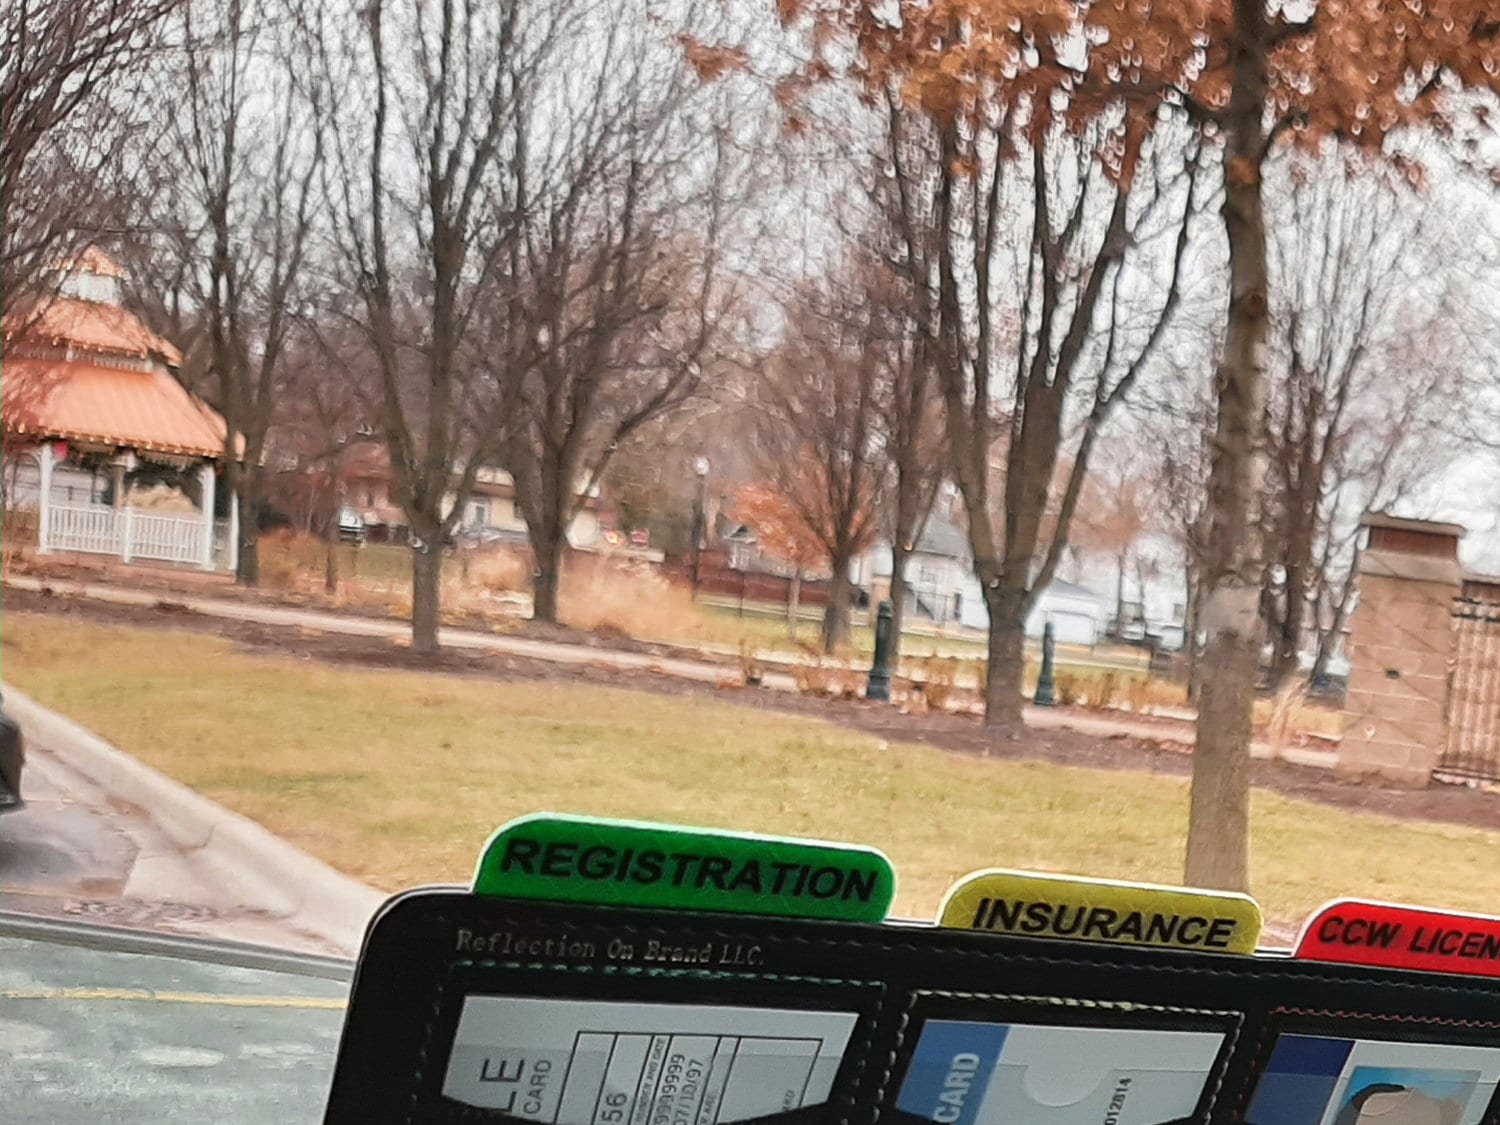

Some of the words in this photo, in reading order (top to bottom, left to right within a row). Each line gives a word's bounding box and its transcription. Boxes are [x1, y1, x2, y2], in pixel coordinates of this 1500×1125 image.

[502, 839, 879, 901] REGISTRATION
[456, 928, 595, 958] Reflection
[607, 938, 634, 960] On
[643, 940, 713, 963] Brand
[972, 898, 1237, 948] INSURANCE
[1317, 916, 1405, 950] CCW
[523, 1059, 552, 1115] CARD
[933, 1053, 979, 1123] CARD
